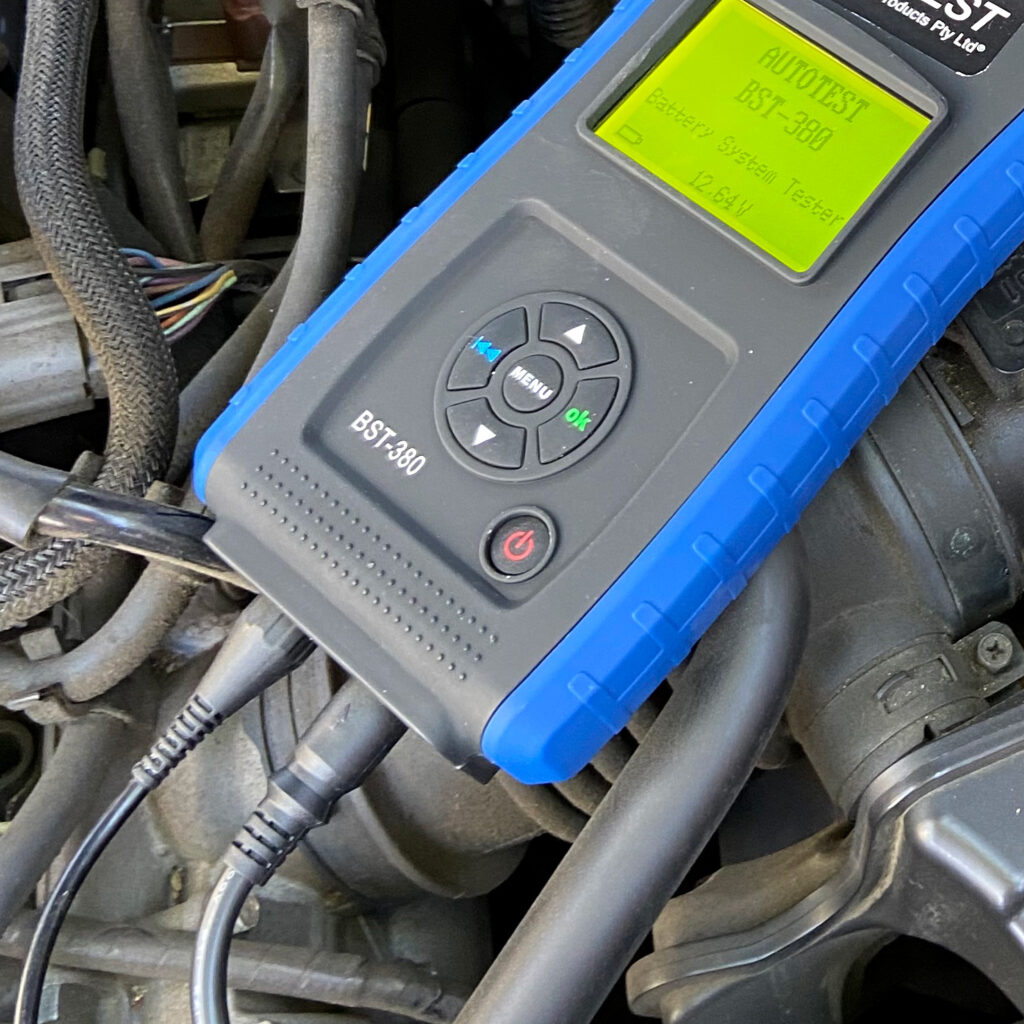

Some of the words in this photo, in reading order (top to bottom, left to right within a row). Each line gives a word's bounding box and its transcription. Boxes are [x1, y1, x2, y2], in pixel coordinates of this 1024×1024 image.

[930, 19, 957, 42] Pty
[734, 78, 834, 152] BST-380
[758, 46, 870, 124] AUTOTEST
[644, 87, 715, 140] Battery
[717, 135, 777, 185] System
[782, 177, 846, 227] Tester
[688, 170, 754, 217] 12.64V
[510, 365, 555, 401] MENU
[350, 409, 427, 476] BST-380
